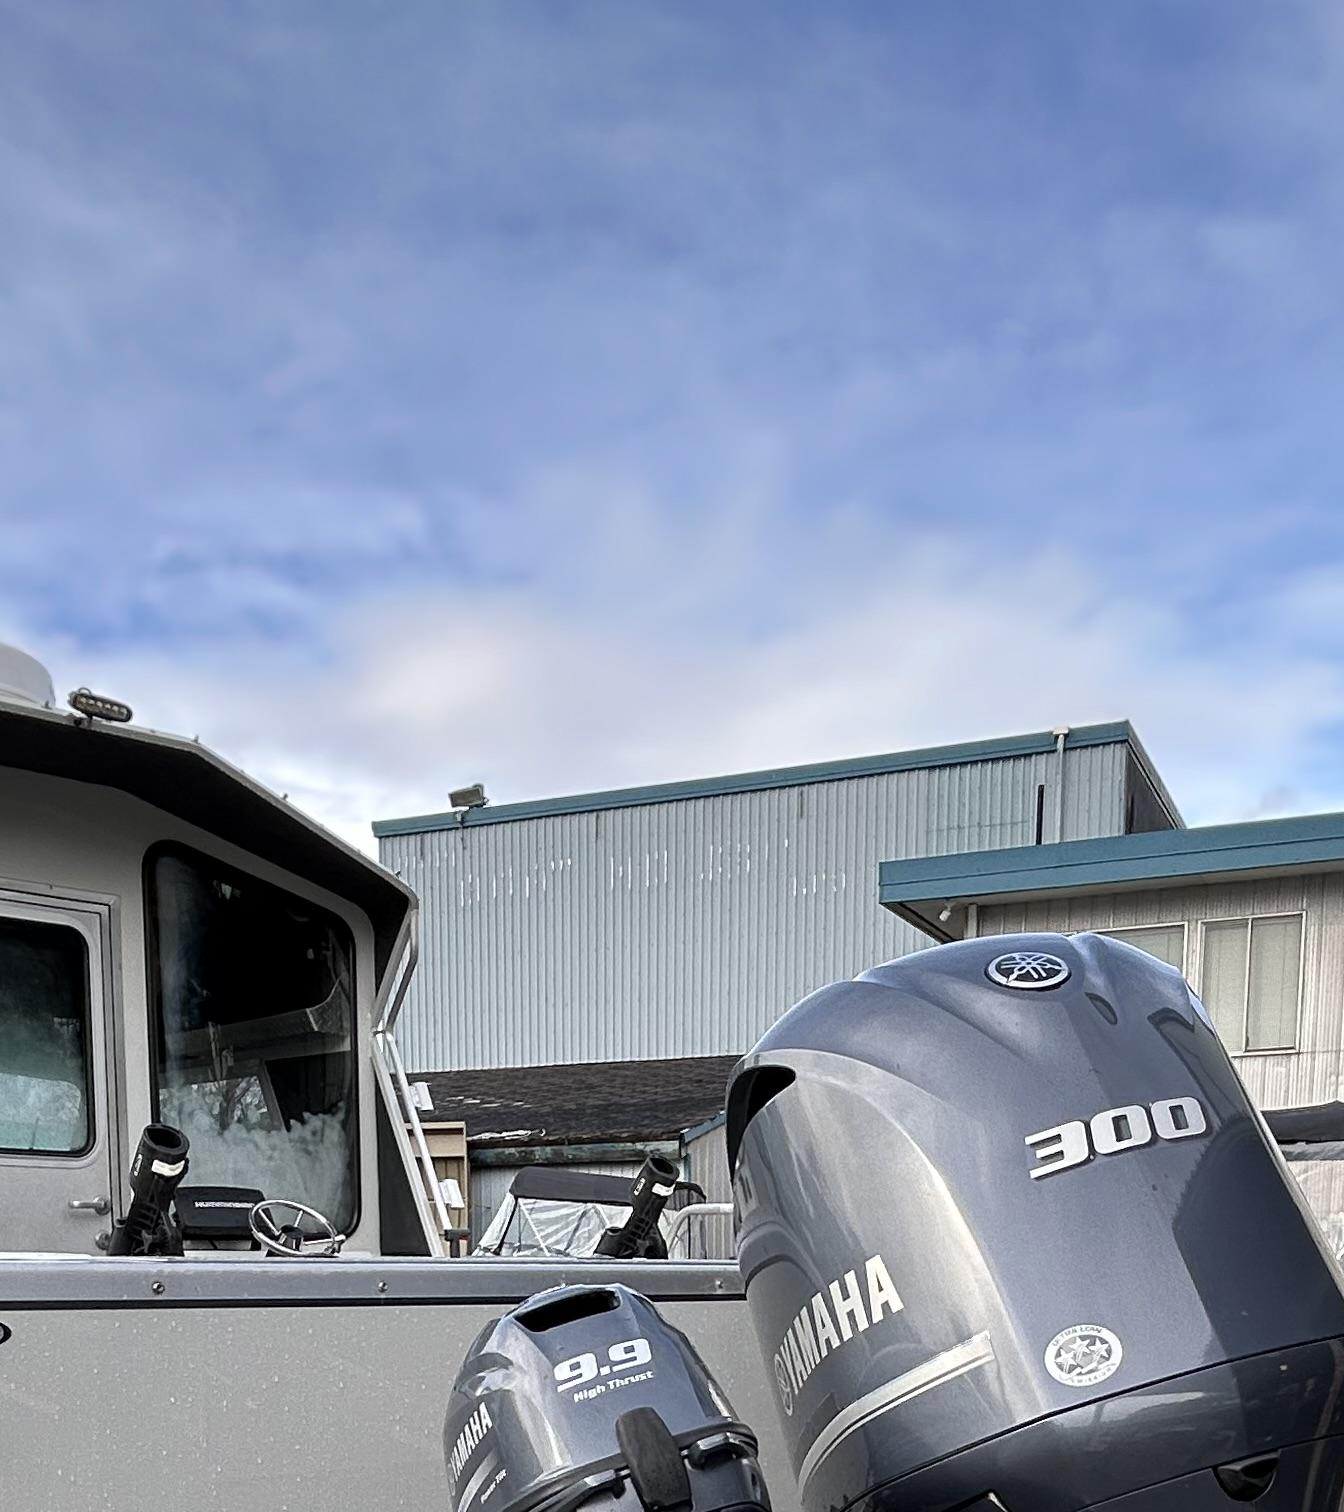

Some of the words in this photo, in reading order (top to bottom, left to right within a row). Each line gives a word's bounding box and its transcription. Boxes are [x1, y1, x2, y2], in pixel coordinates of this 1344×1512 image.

[1025, 1097, 1206, 1179] 300
[554, 1338, 652, 1393] 9.9
[780, 1254, 905, 1396] YAMAHA
[573, 1384, 606, 1403] High
[606, 1370, 655, 1390] Thrust
[450, 1401, 493, 1482] YAMAHA
